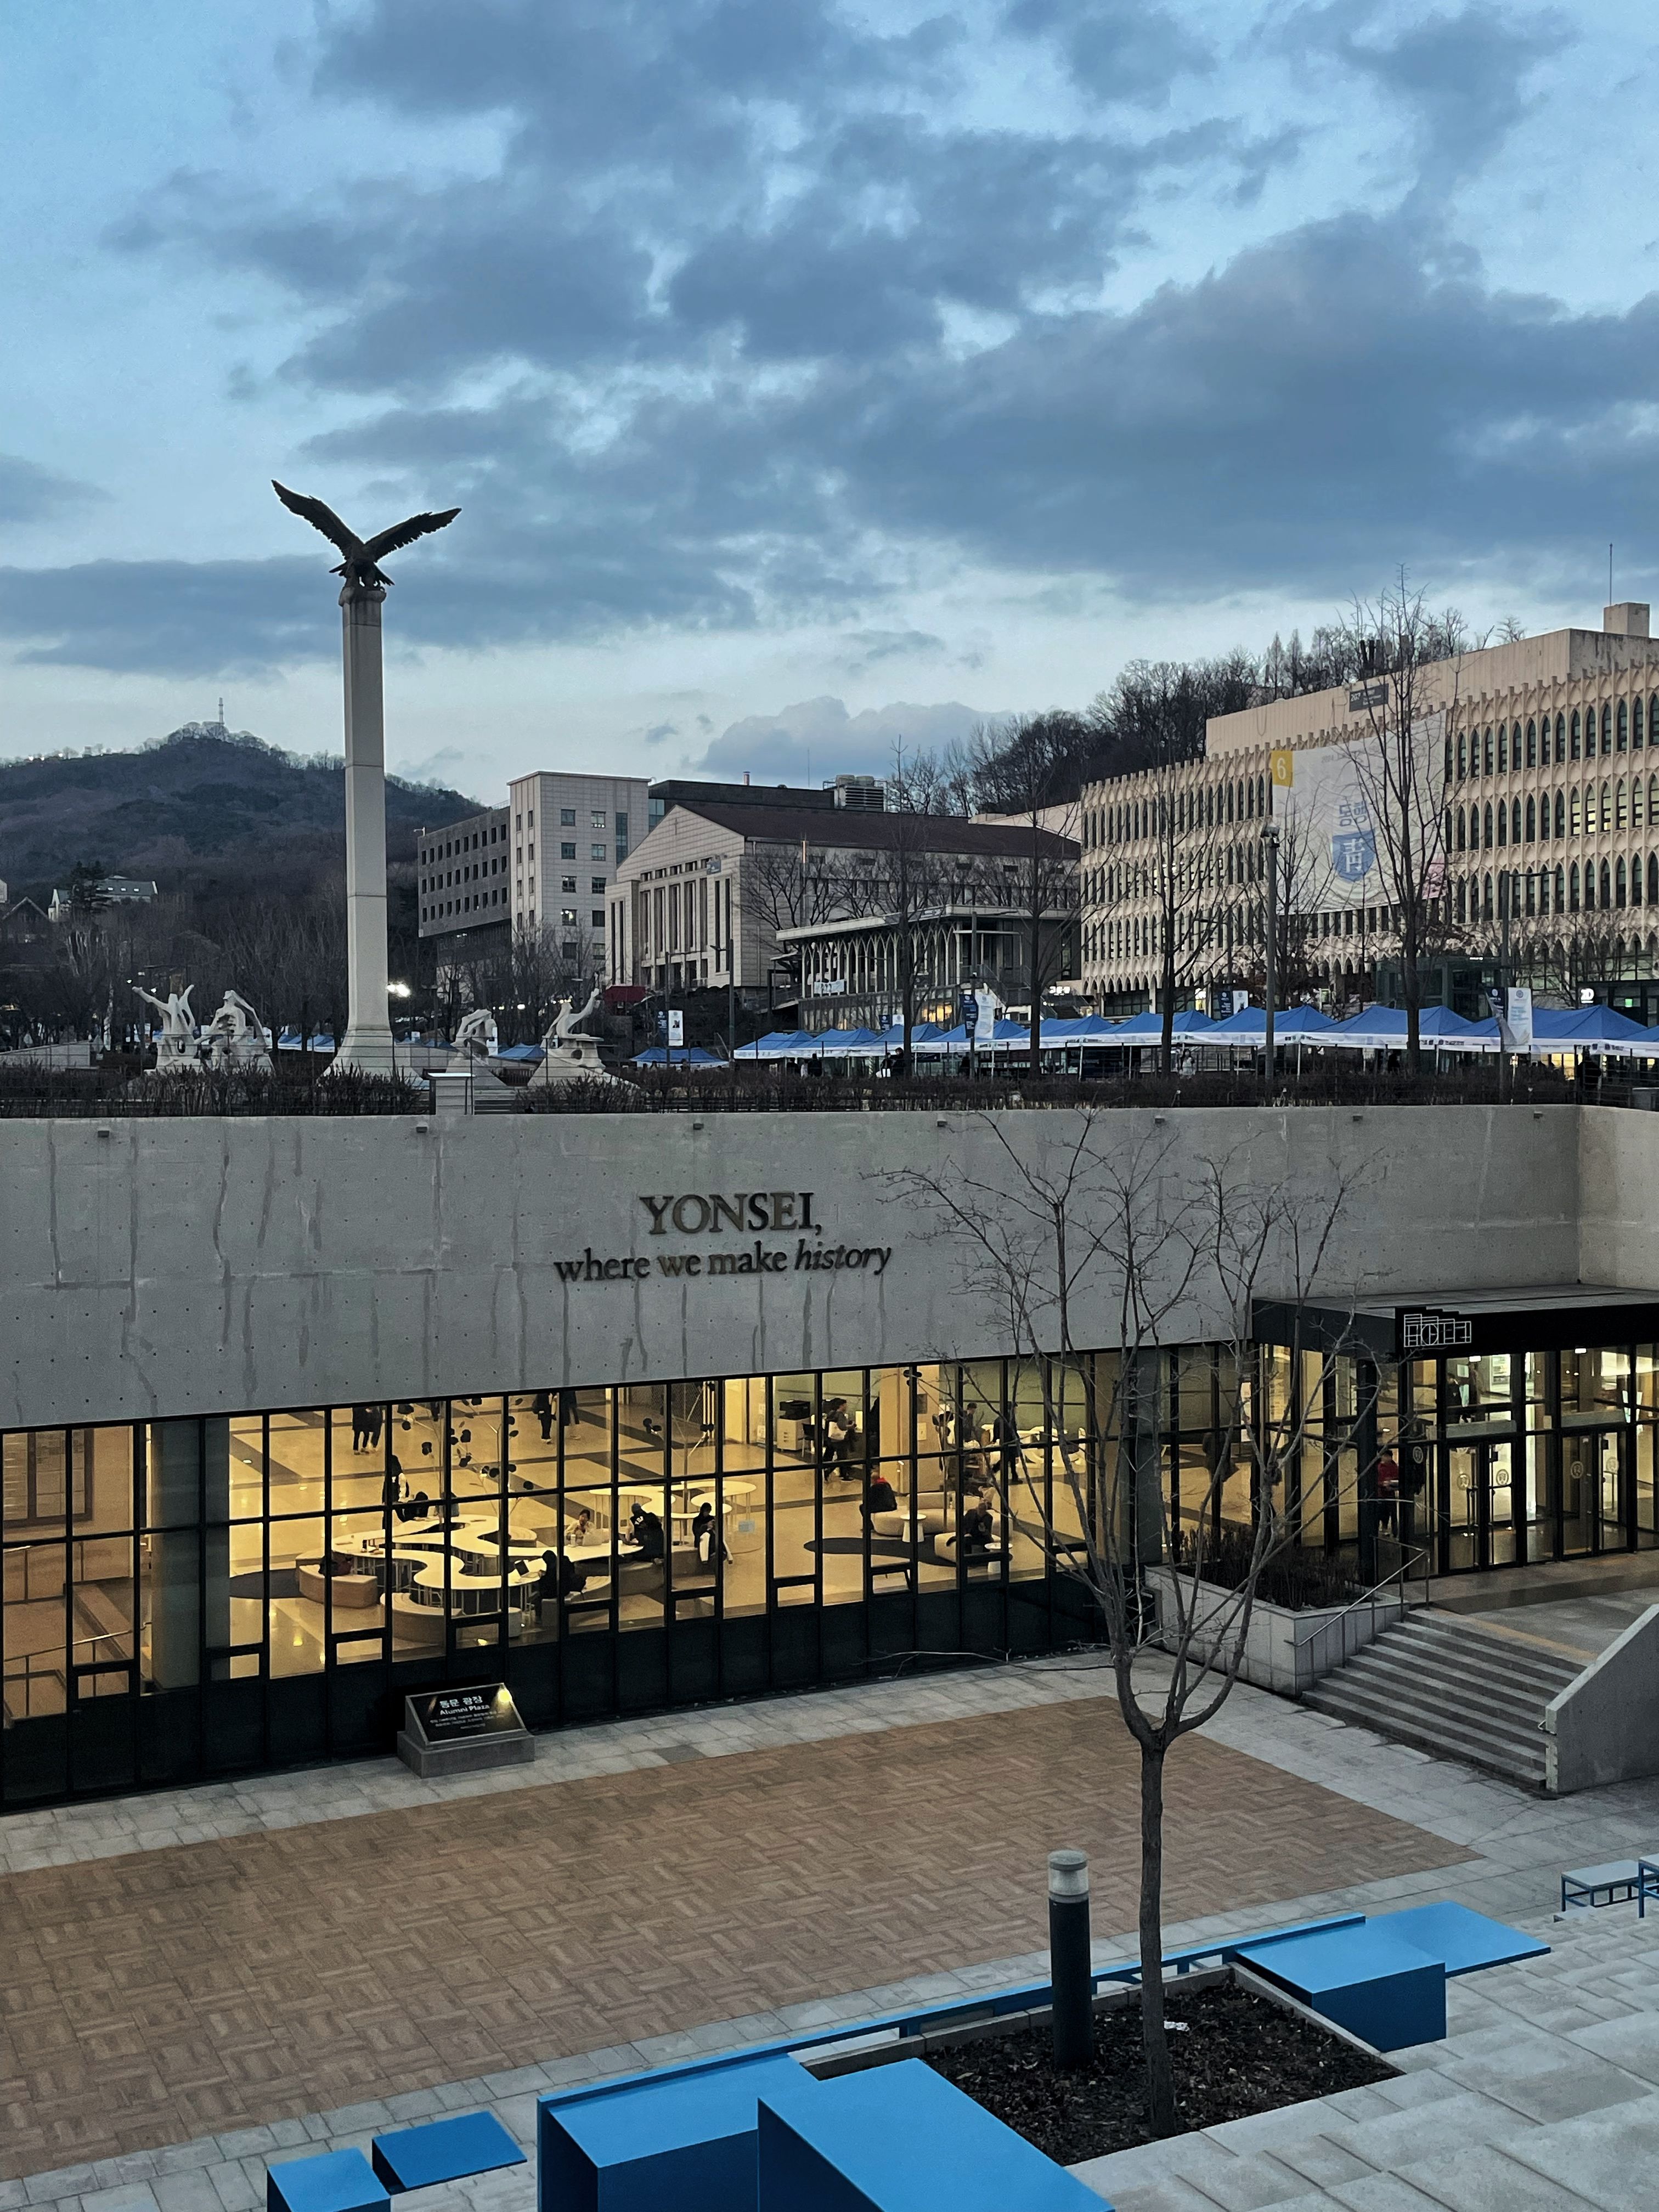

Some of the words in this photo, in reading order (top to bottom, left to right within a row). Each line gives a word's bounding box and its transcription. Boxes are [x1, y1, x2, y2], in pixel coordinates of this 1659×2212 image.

[1277, 758, 1286, 780] 6
[639, 1192, 822, 1235] YONSEI,
[554, 1248, 651, 1283] where
[657, 1253, 701, 1278] we
[708, 1241, 788, 1276] make
[794, 1238, 892, 1276] history
[440, 1707, 468, 1716] Alumni
